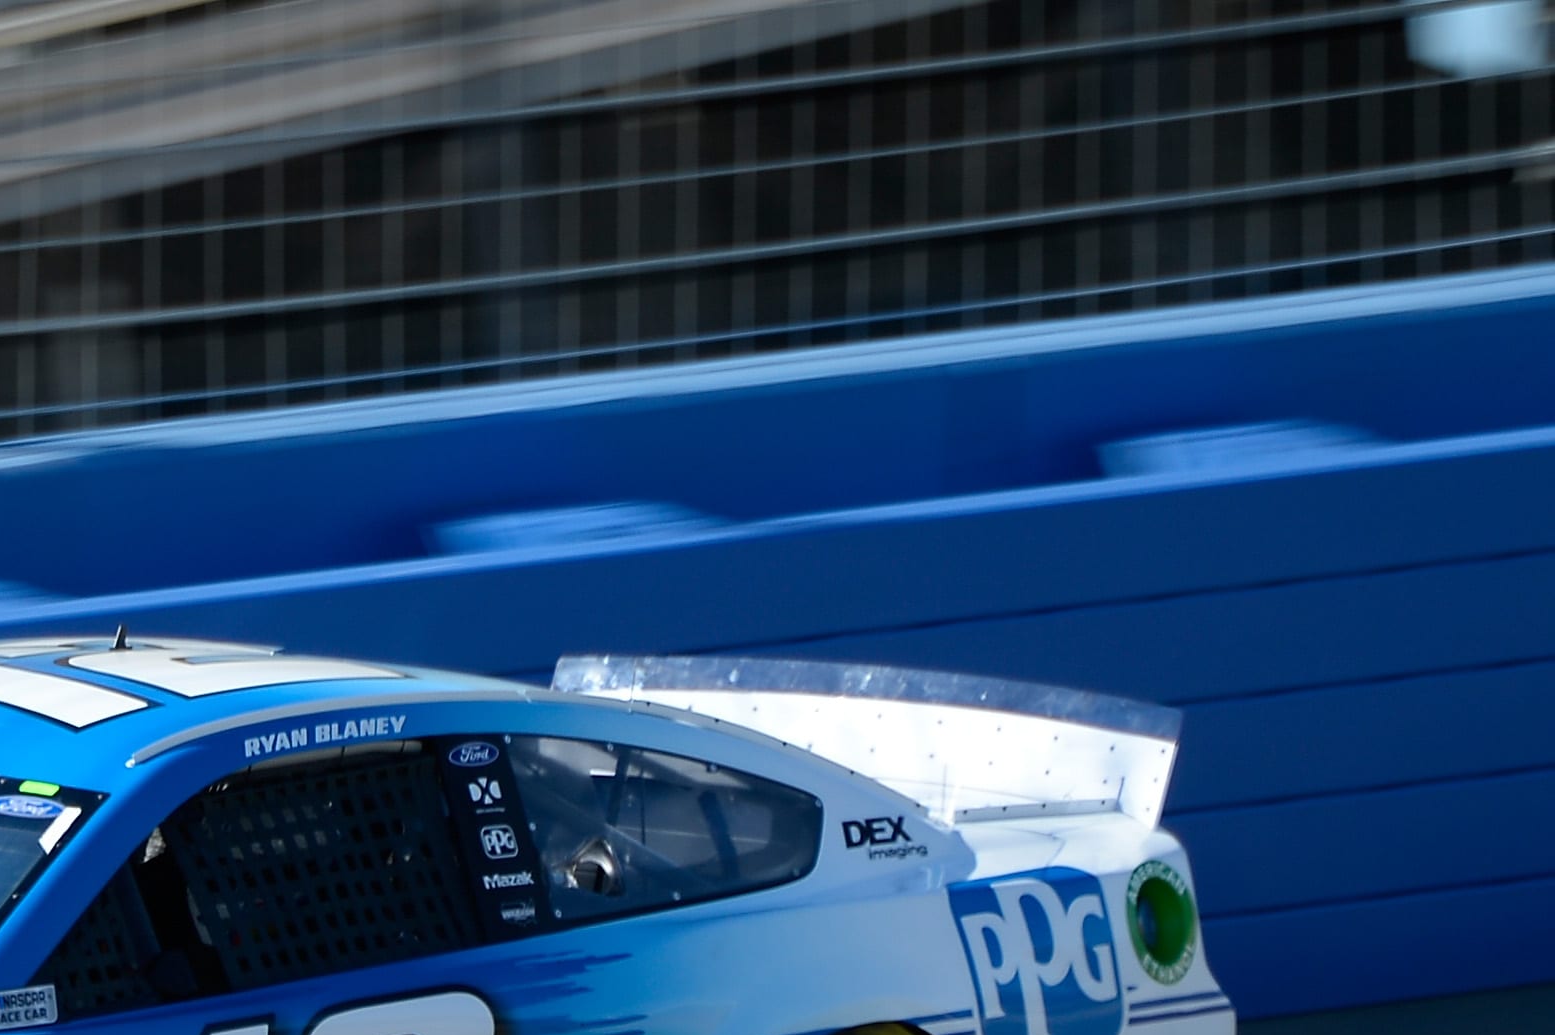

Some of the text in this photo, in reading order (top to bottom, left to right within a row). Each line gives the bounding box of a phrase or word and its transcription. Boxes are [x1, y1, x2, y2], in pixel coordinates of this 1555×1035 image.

[244, 715, 407, 758] RYAN BLANEY
[459, 745, 490, 764] Ford
[841, 815, 912, 848] DEX
[482, 871, 535, 889] Mazak
[1, 991, 46, 1009] NASCAR
[24, 1007, 48, 1021] CAR
